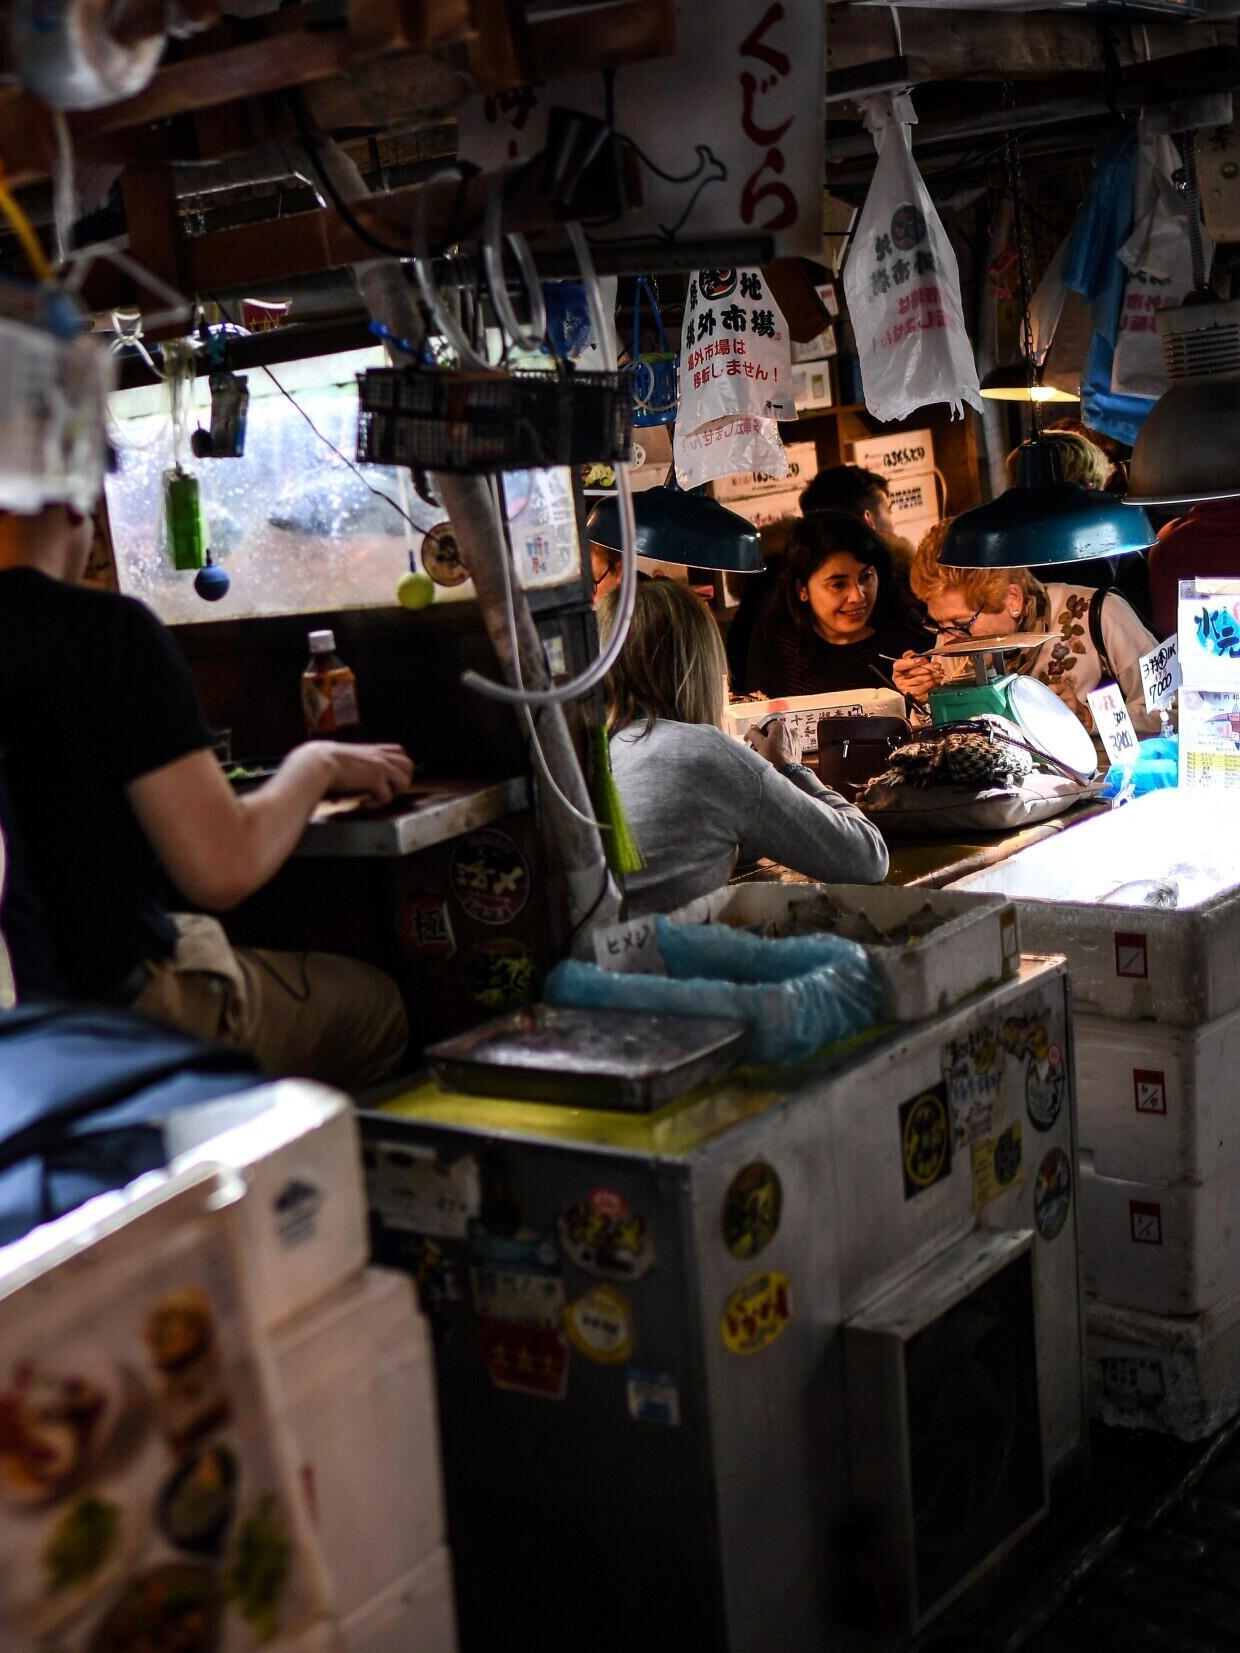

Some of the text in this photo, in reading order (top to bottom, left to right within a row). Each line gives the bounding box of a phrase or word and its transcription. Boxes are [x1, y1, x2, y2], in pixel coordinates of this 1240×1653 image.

[739, 2, 798, 231] くじら
[740, 272, 763, 301] 地
[687, 338, 746, 371] 場外市場は
[693, 359, 778, 390] 移転しません！
[1149, 672, 1172, 704] 7000
